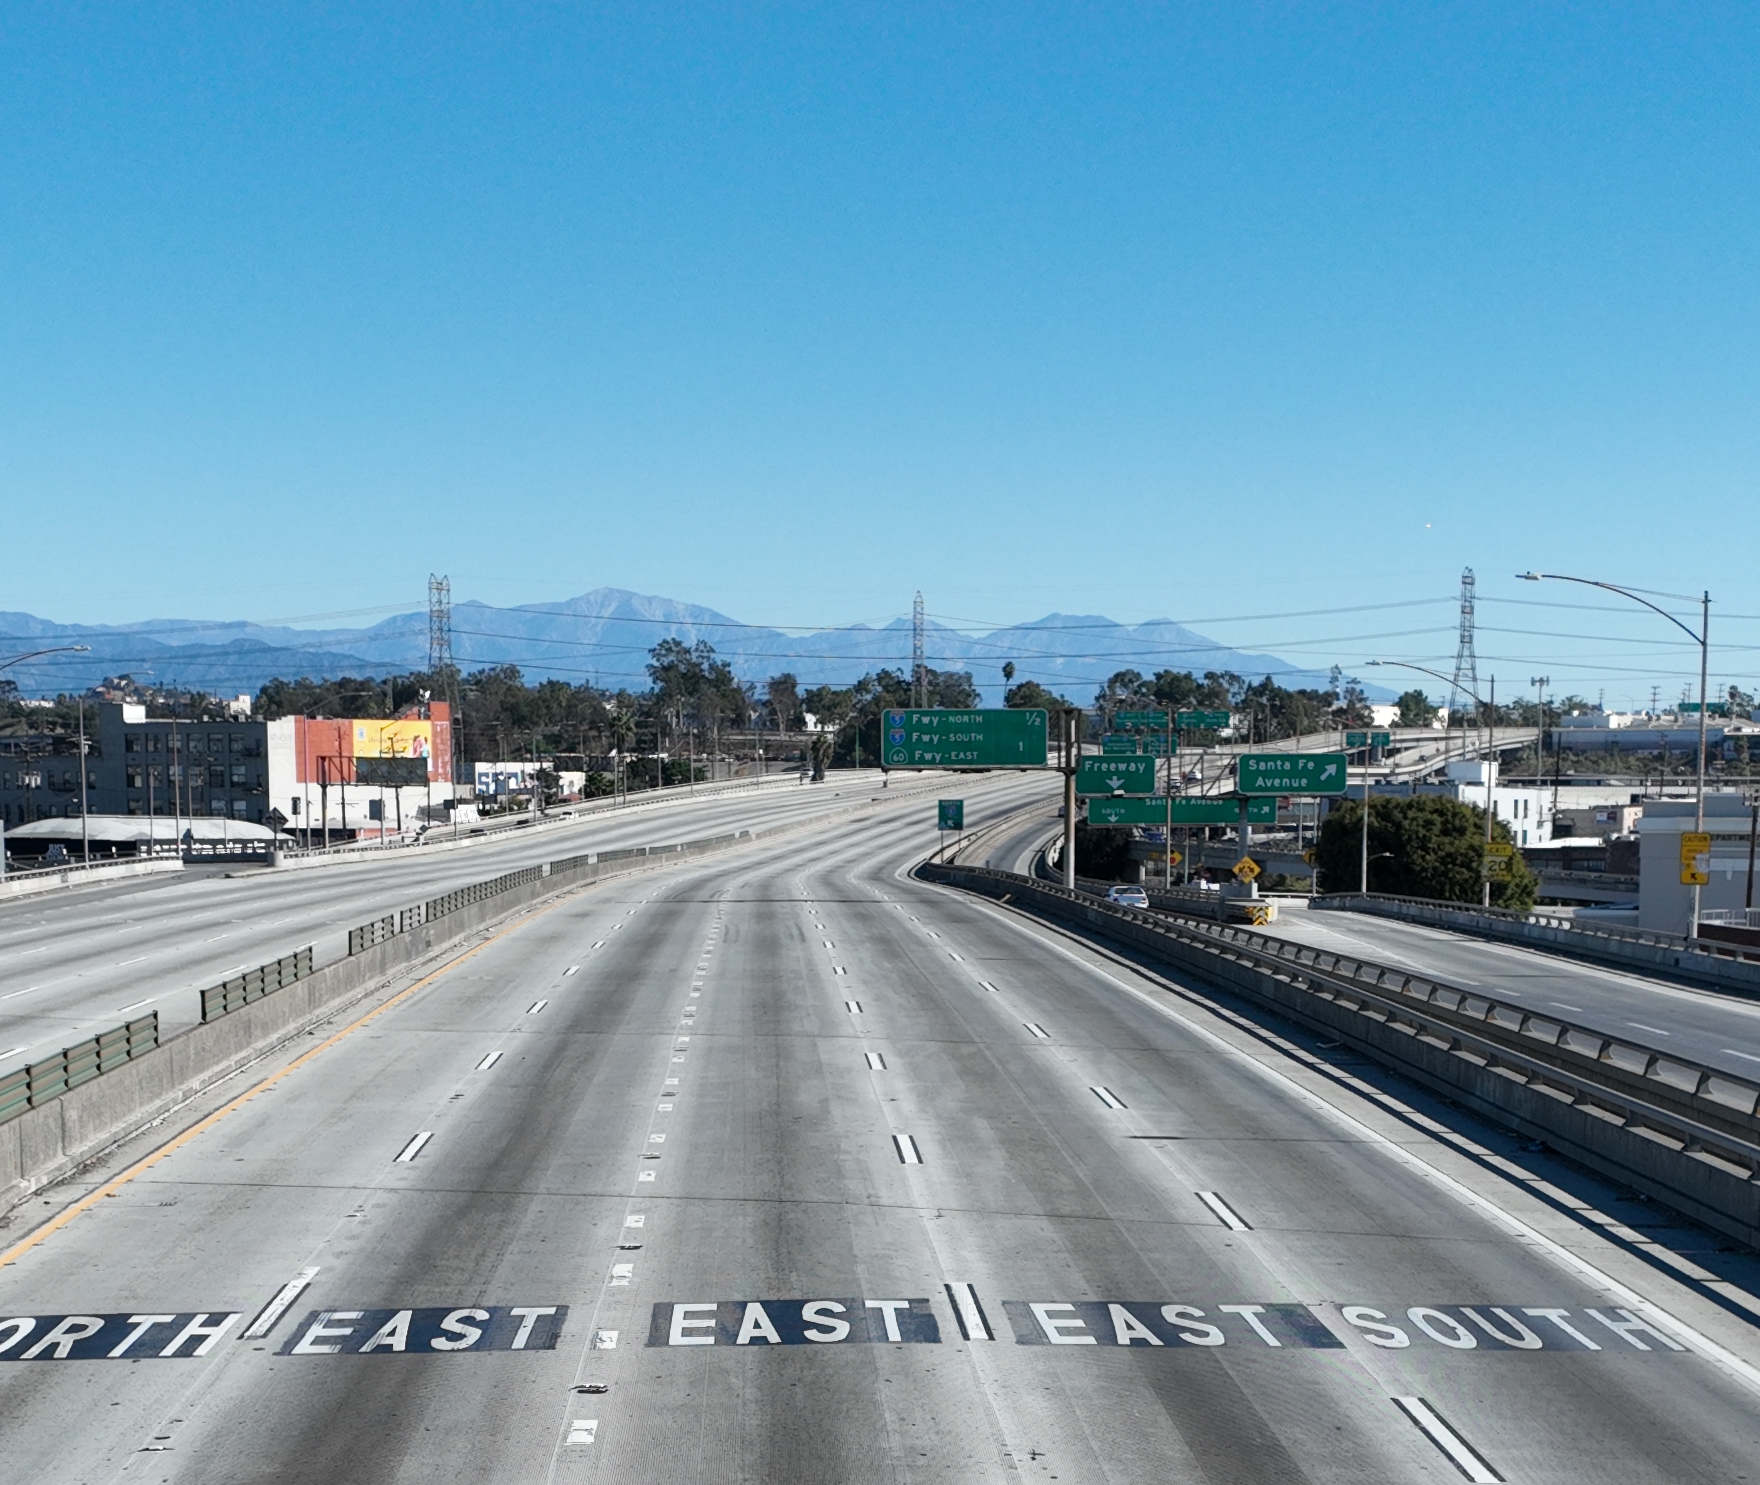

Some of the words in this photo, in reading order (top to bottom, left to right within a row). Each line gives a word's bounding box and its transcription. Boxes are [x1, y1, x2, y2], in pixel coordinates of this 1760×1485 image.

[1084, 761, 1146, 773] Freeway
[1248, 759, 1290, 771] Santa
[1298, 760, 1315, 771] Fe
[1255, 776, 1308, 788] Avenue
[1488, 860, 1509, 872] 20
[290, 1306, 558, 1355] EAST
[667, 1300, 914, 1346] EAST
[1023, 1302, 1285, 1348] EAST
[1341, 1306, 1688, 1352] SOUTH
